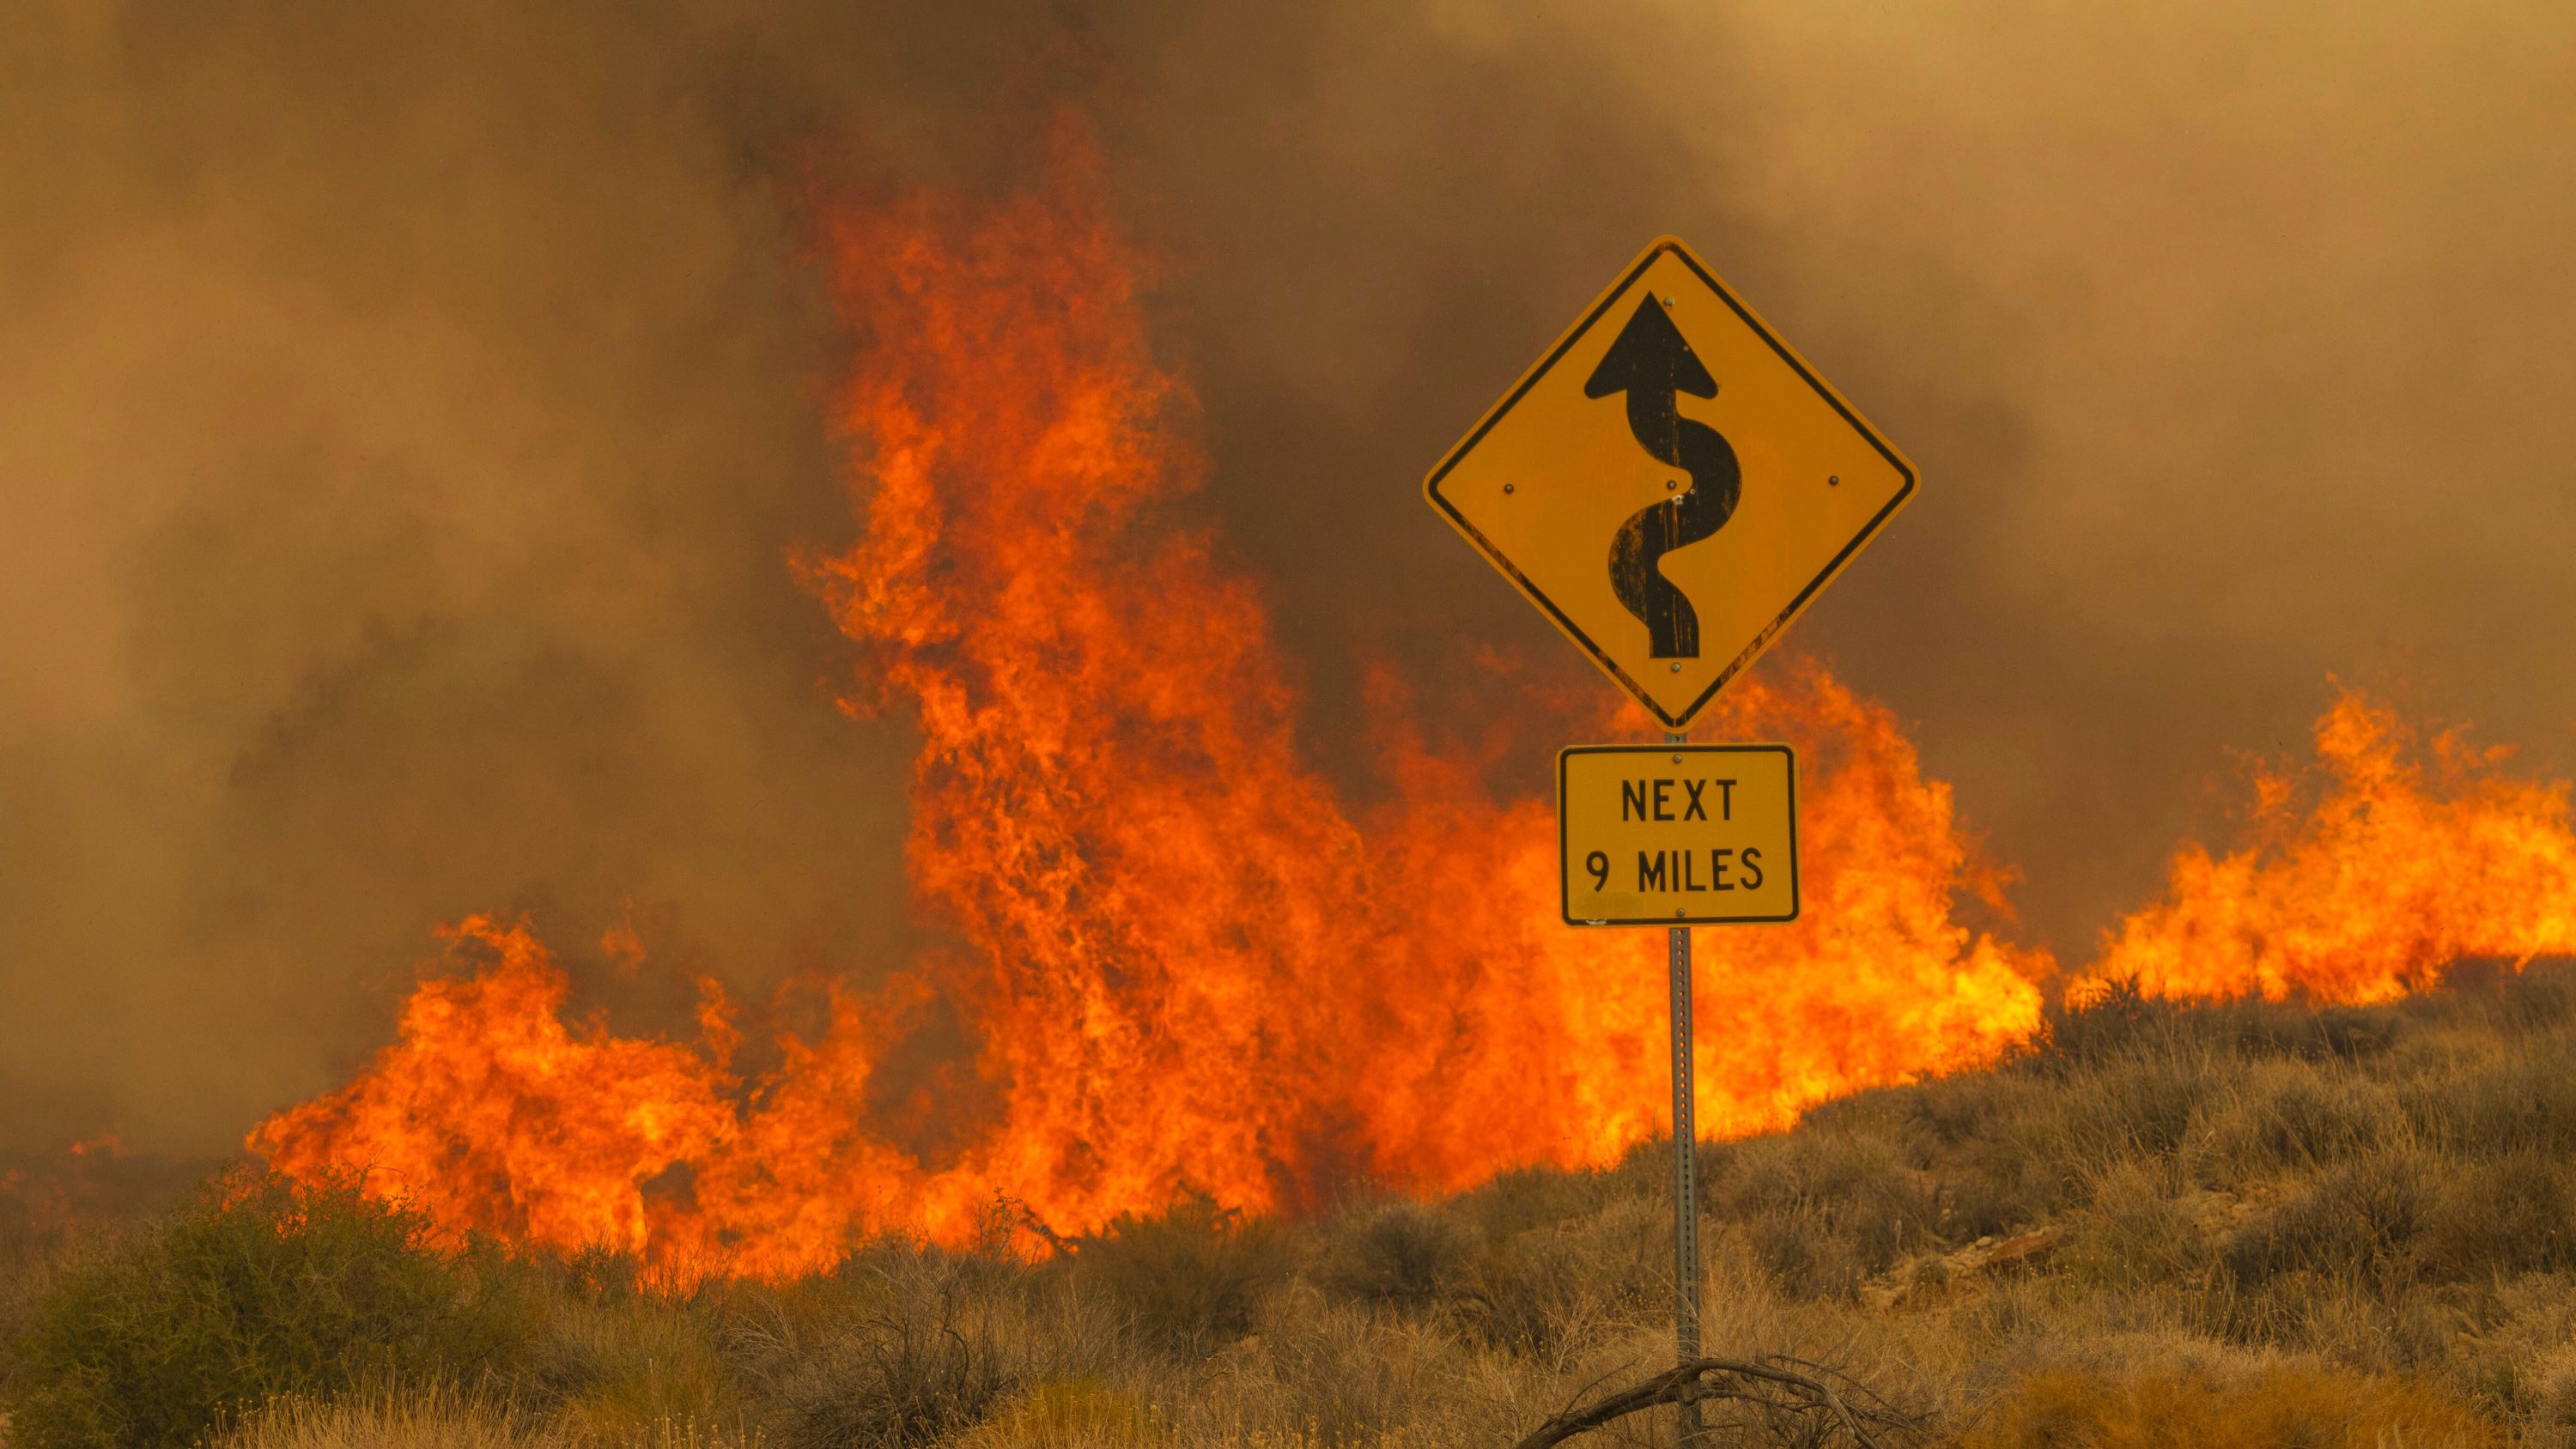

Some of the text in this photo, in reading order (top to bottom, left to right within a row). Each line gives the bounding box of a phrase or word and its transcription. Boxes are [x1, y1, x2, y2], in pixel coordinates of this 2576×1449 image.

[1621, 779, 1738, 822] NEXT
[1585, 846, 1764, 894] 9 MILES
